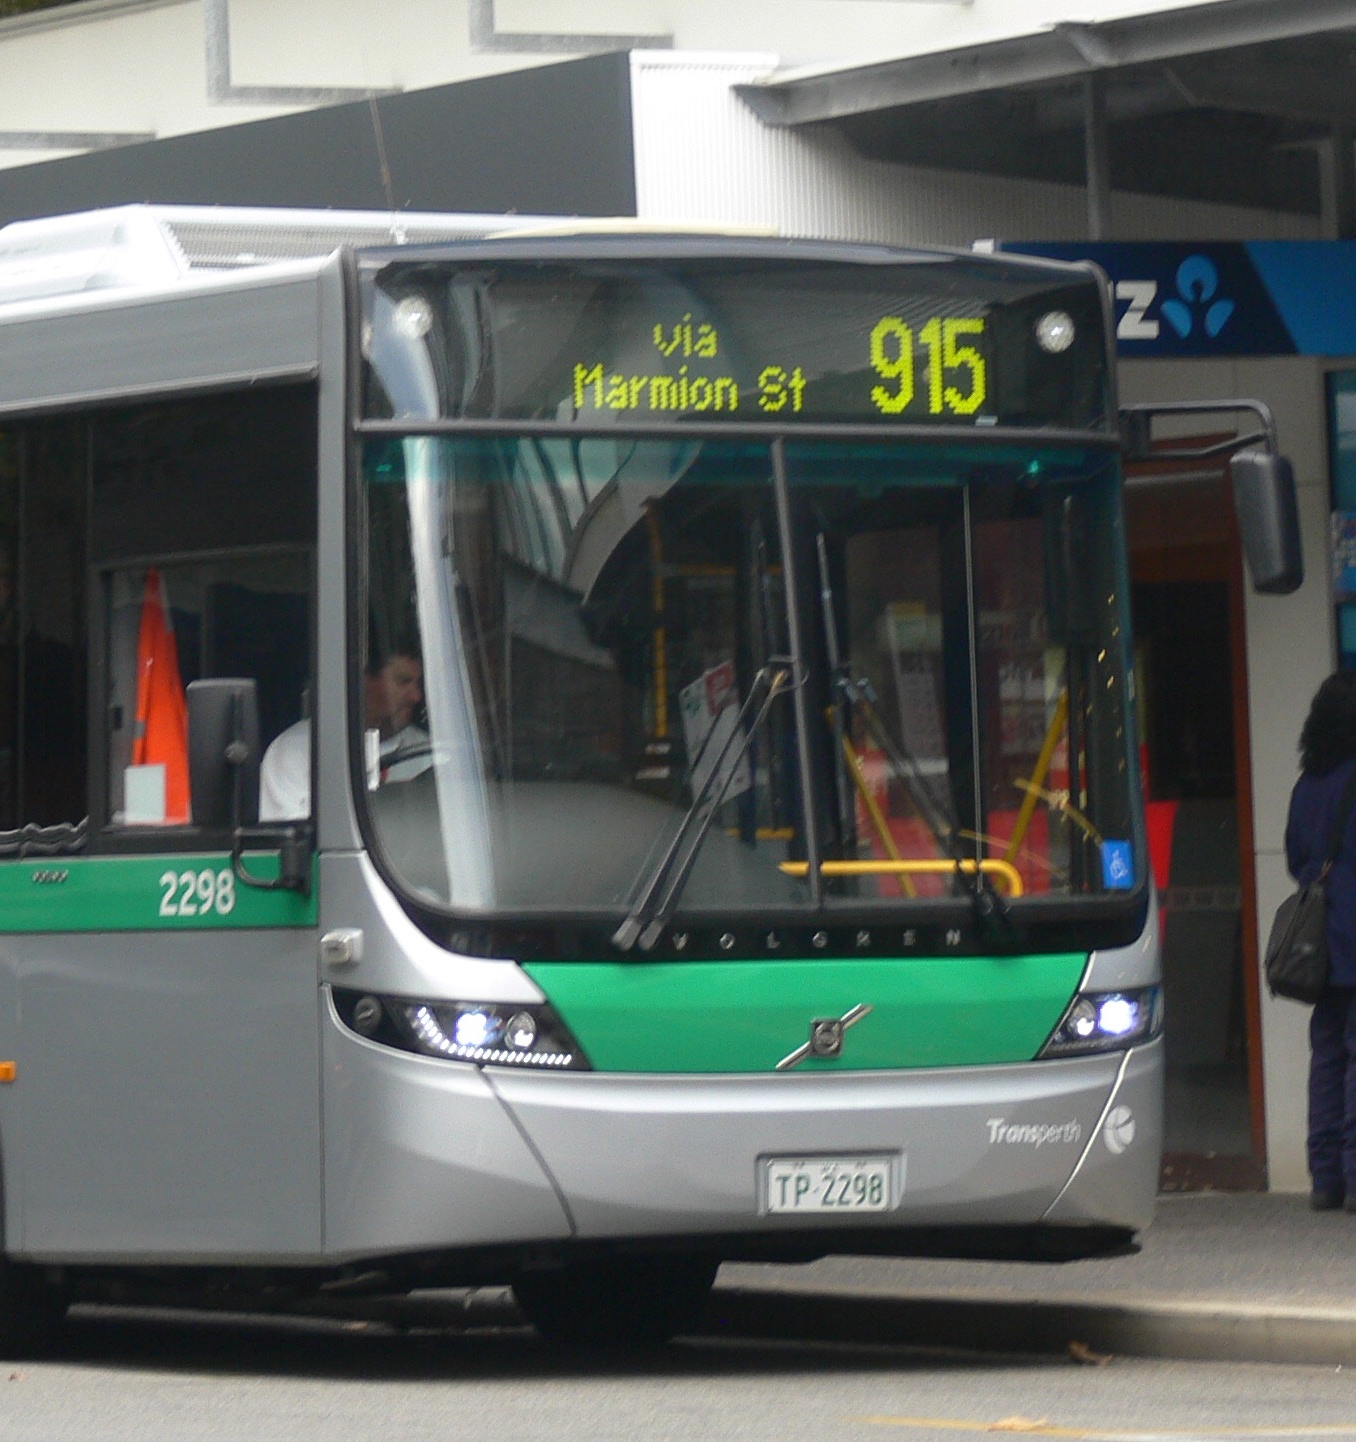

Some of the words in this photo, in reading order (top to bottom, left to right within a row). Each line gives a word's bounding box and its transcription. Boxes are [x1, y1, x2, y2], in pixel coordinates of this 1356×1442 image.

[652, 313, 717, 358] via
[574, 362, 738, 412] Marmion
[758, 365, 806, 412] St
[870, 316, 986, 415] 915
[159, 869, 235, 916] 2298
[986, 1117, 1081, 1149] Transperth
